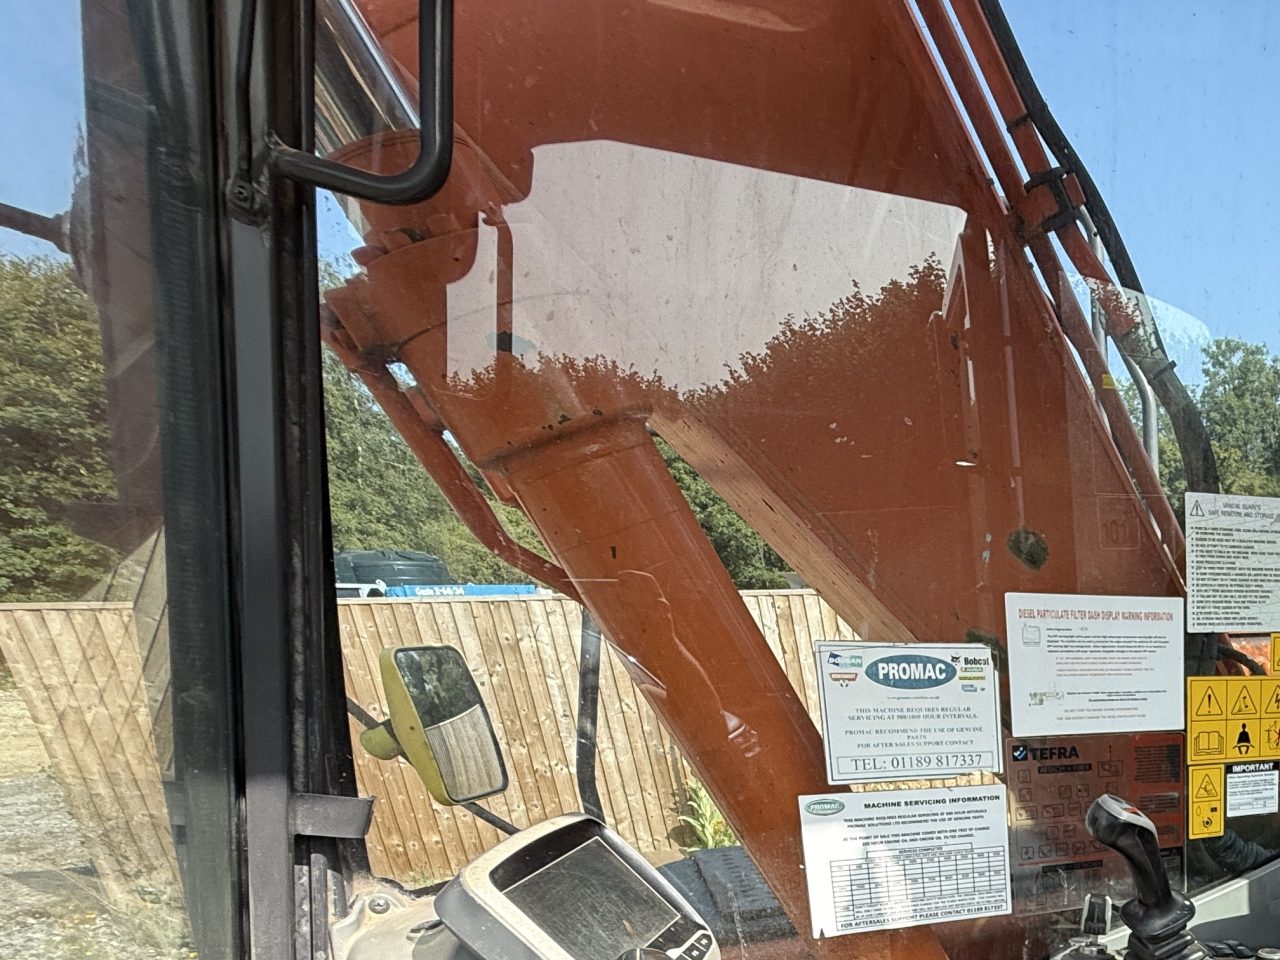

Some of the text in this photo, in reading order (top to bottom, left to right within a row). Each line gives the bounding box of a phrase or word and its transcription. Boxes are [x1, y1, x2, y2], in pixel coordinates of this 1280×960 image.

[1018, 608, 1173, 621] DIESEL PARTICULATE FILTER DASH DISPLAY WARNING INFORMATION
[877, 663, 947, 680] PROMAC
[1029, 746, 1079, 760] TEFRA
[851, 754, 982, 771] TEL: 01189 817337
[1232, 762, 1274, 773] IMPORTANT
[810, 803, 841, 811] PROMAC
[864, 795, 1000, 809] MACHINE SERVICING INFORMATION
[854, 918, 890, 928] AFTERSALES
[891, 914, 918, 923] SUPPORT
[919, 912, 940, 920] PLEASE
[940, 909, 966, 918] CONTACT
[984, 904, 1003, 912] 817337
